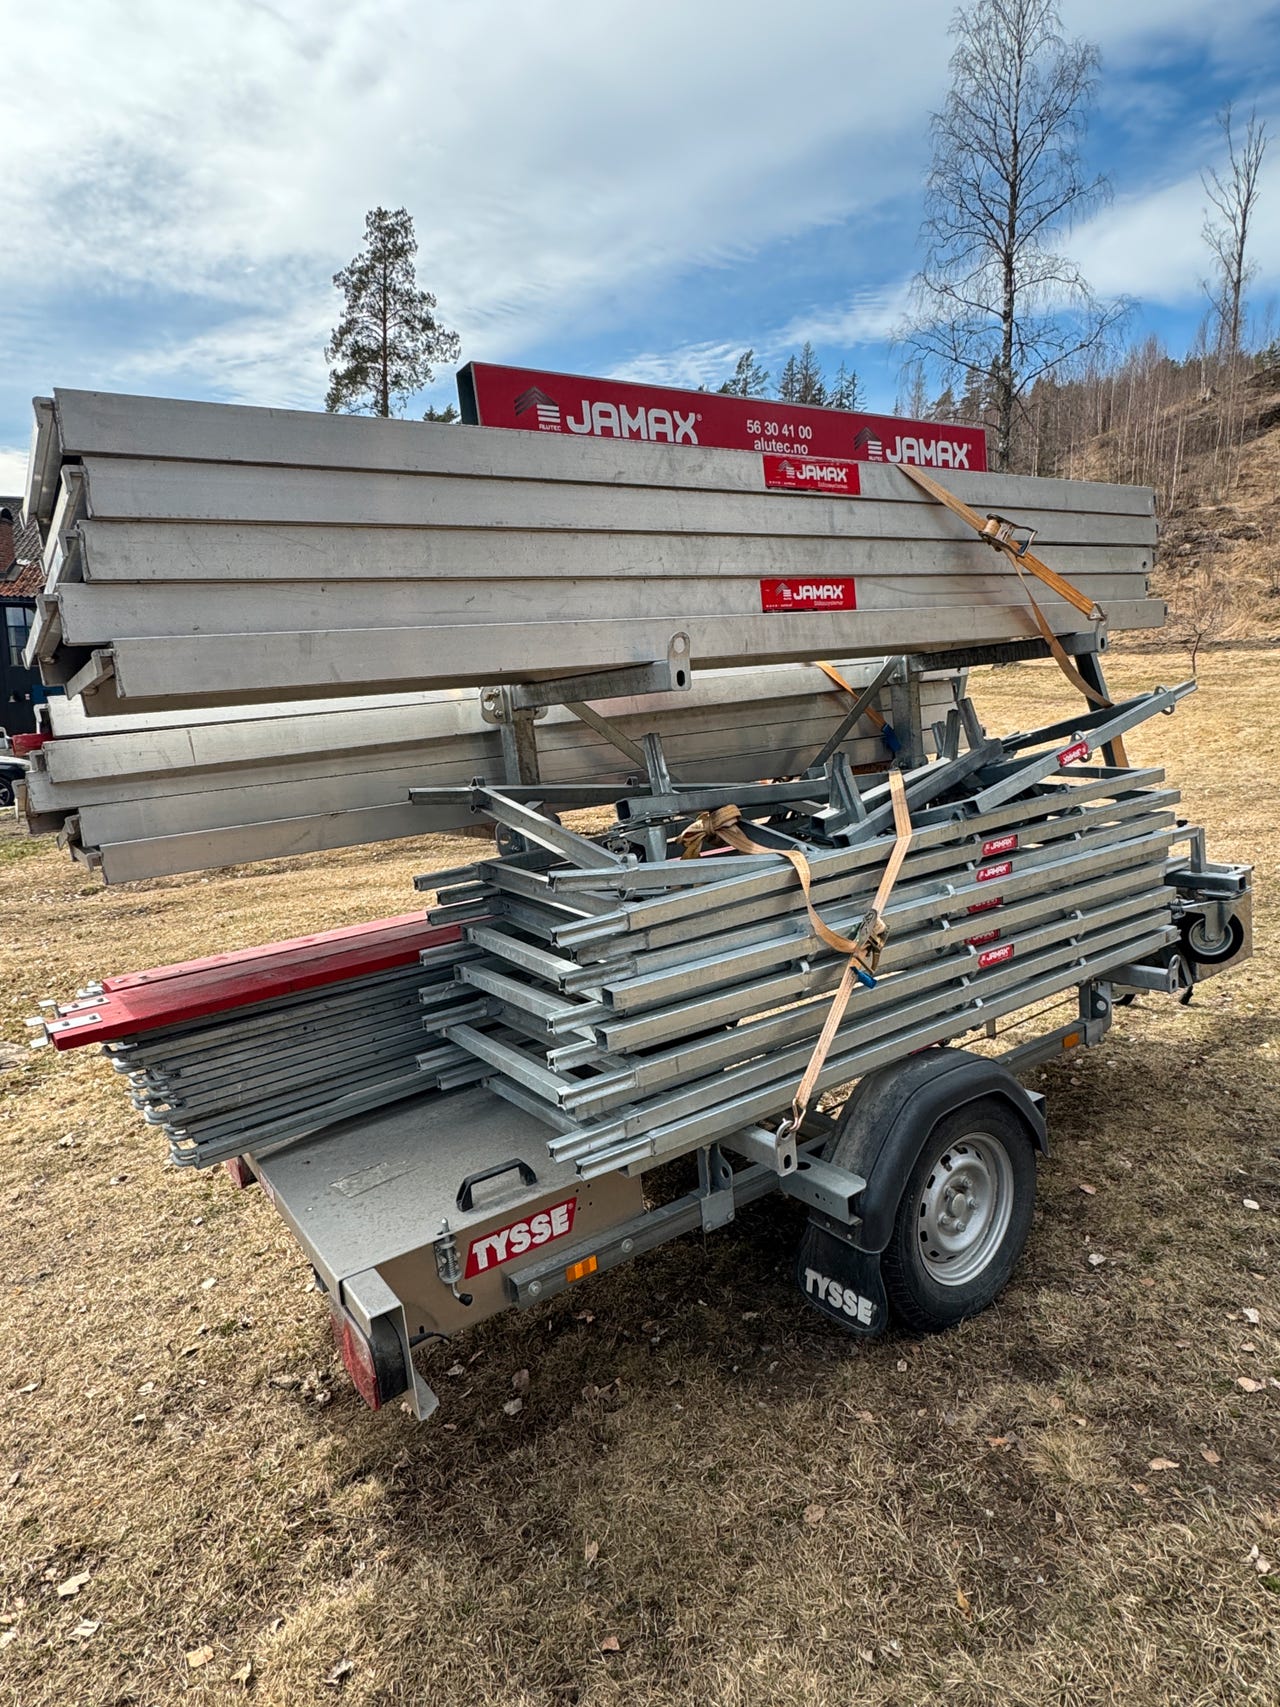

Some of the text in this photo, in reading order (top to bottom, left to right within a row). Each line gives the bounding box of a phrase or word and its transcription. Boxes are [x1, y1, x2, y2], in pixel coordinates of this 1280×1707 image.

[539, 424, 561, 432] ALUTEC
[566, 400, 698, 444] JAMAX
[746, 419, 812, 440] 56 30 41 00
[754, 437, 808, 455] alutec.no
[886, 436, 969, 469] JAMAX
[796, 464, 847, 483] JAMAX
[793, 585, 843, 600] JAMAX
[472, 1204, 569, 1270] TYSSE
[804, 1268, 873, 1325] TYSSE
